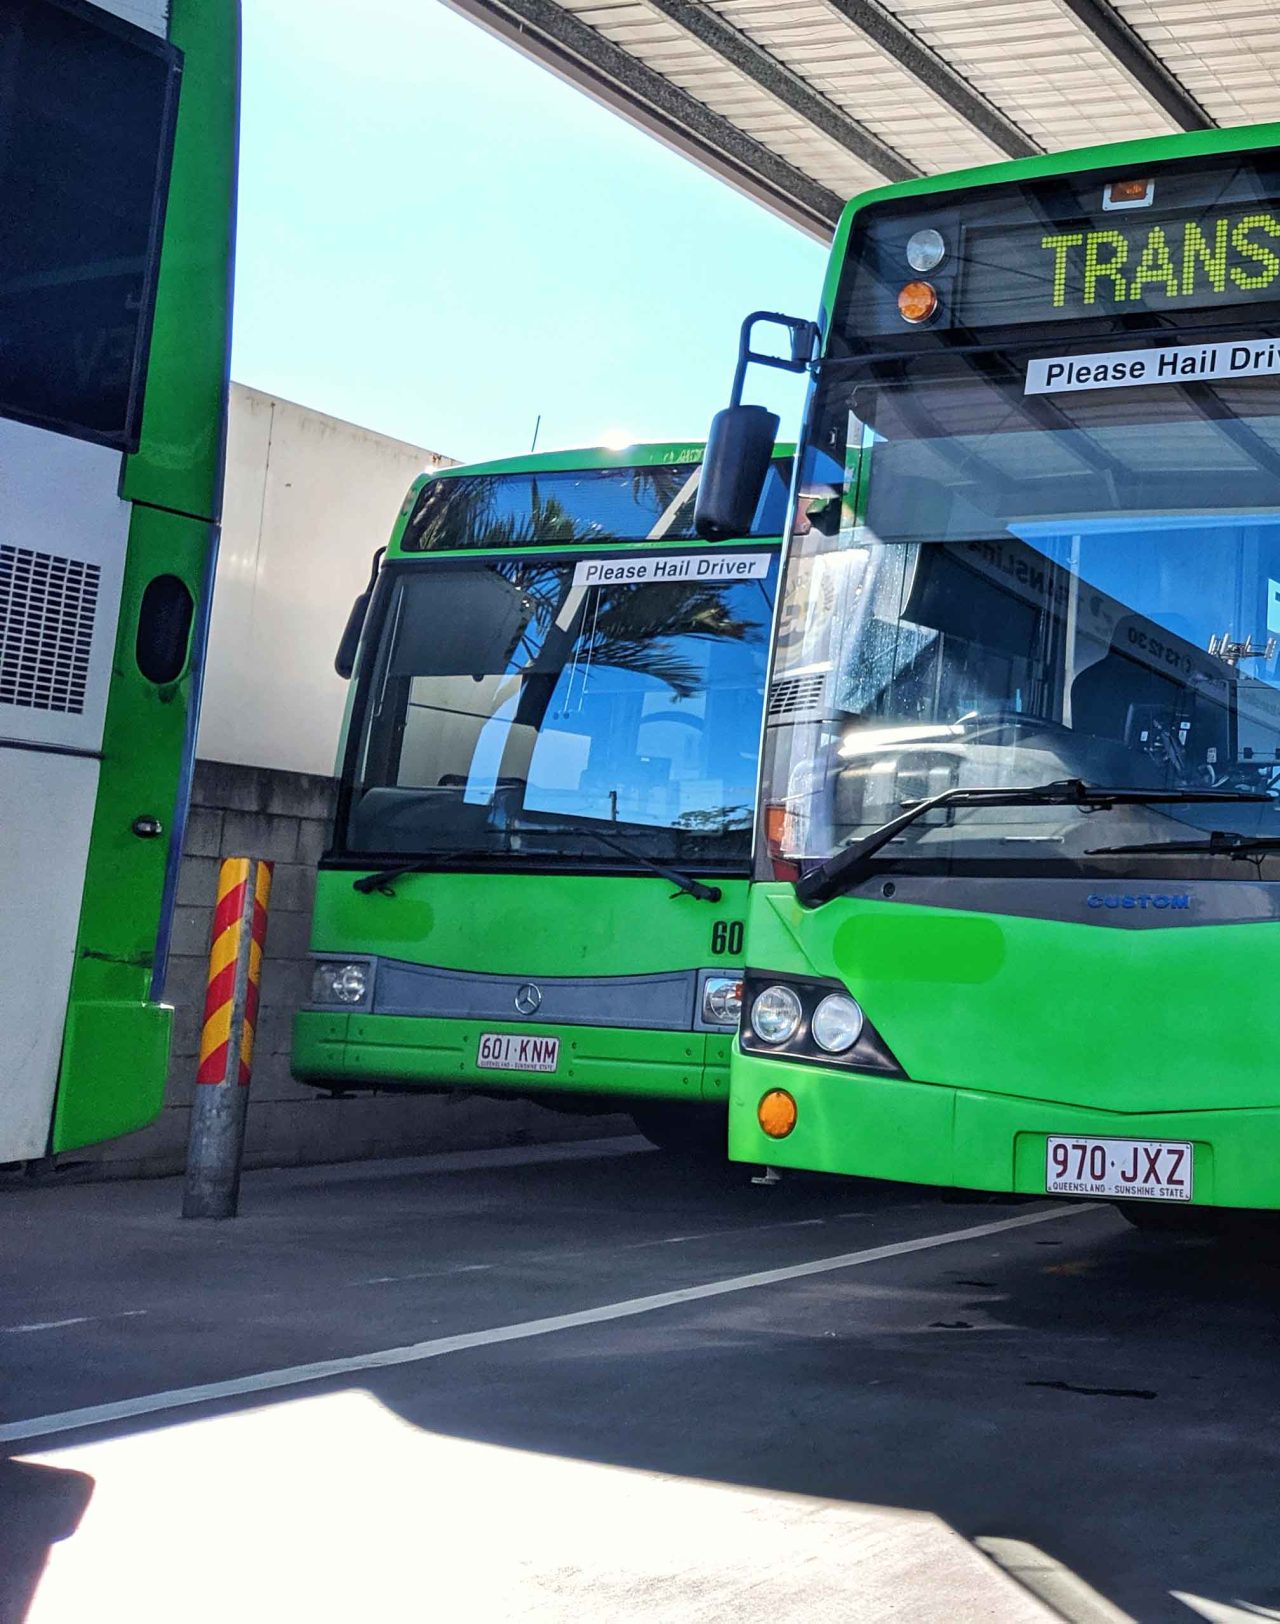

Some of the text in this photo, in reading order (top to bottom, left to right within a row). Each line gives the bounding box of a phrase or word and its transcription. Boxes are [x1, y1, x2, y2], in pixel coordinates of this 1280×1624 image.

[1045, 361, 1146, 387] Please
[1157, 349, 1217, 377] Hail
[586, 559, 756, 581] Please Hail Driver
[1086, 893, 1191, 910] CUSTOM
[711, 920, 744, 955] 60
[518, 1039, 557, 1064] KNM
[1052, 1143, 1185, 1186] 970 JXZ
[1052, 1181, 1106, 1193] QUEENSLAND
[1114, 1185, 1155, 1196] SUNSHINE
[1159, 1187, 1184, 1198] STATE
